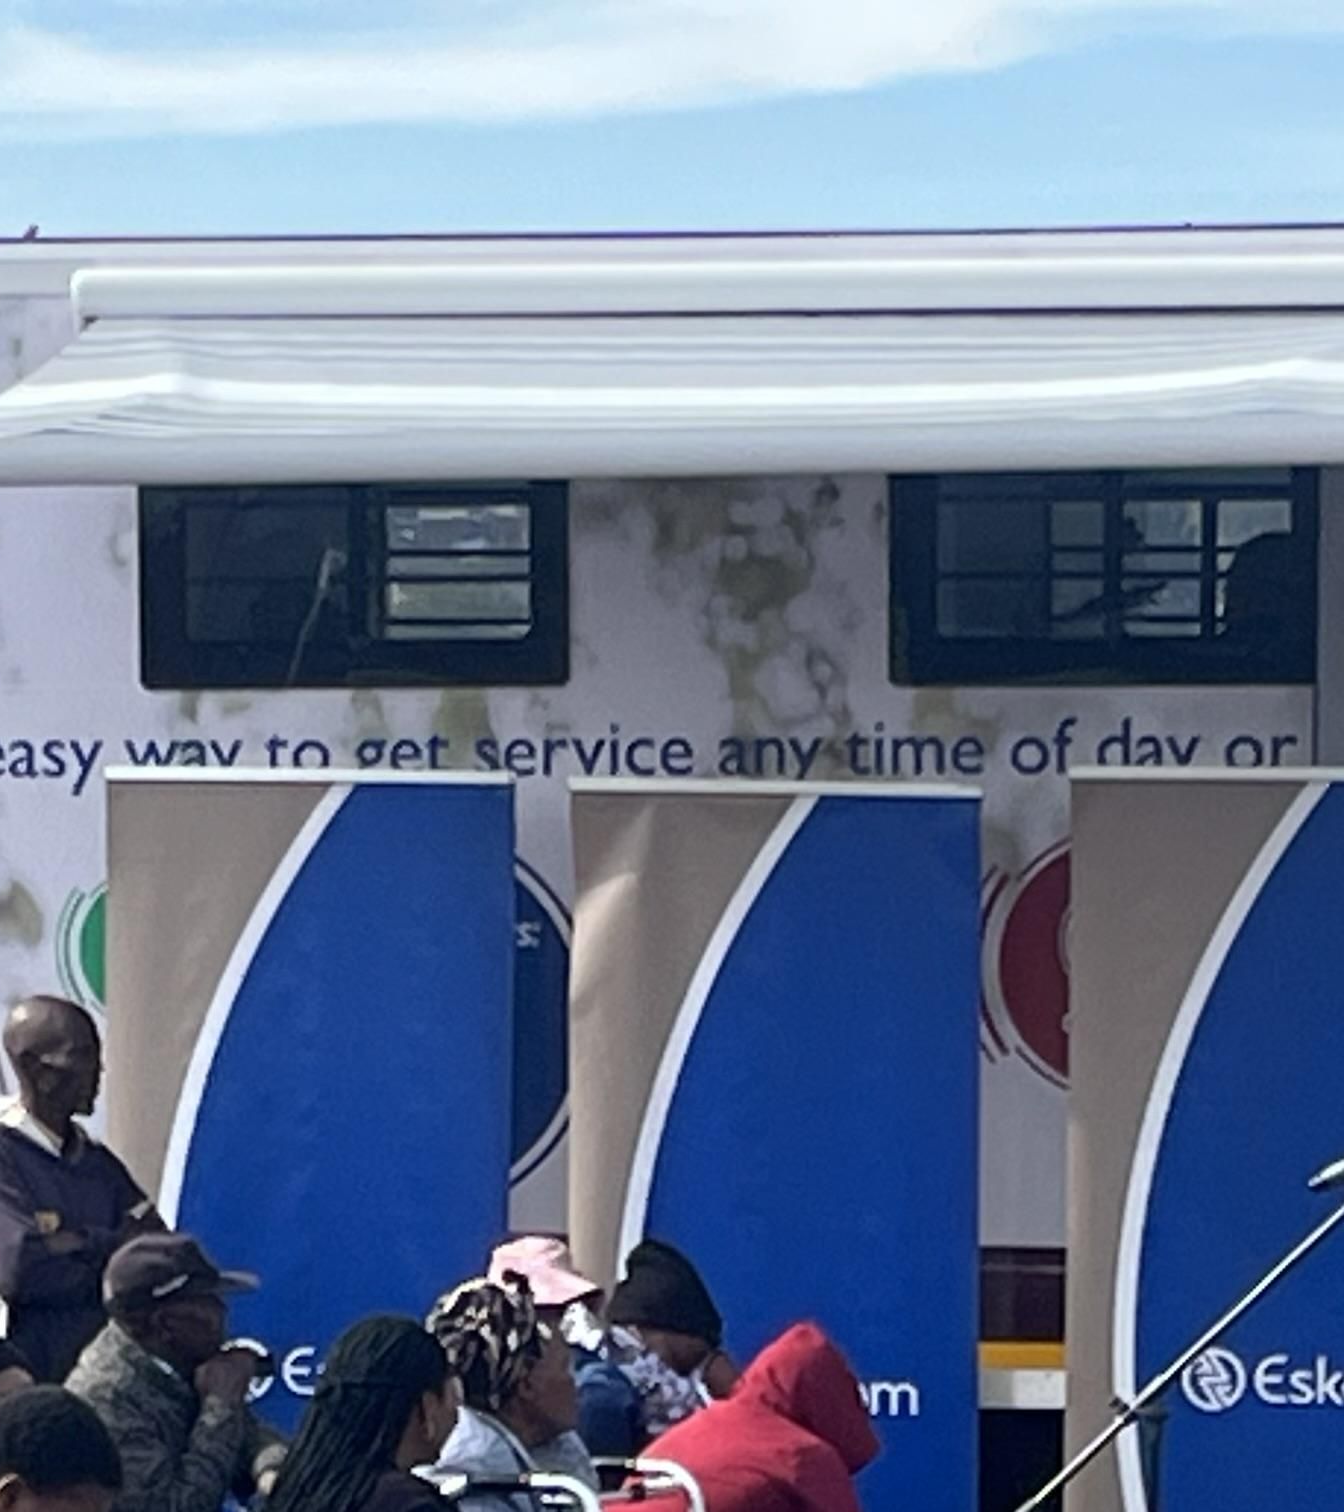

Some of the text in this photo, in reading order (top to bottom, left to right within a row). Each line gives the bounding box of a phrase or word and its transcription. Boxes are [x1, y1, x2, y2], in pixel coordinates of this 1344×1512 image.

[122, 737, 244, 767] way
[264, 732, 331, 768] to
[474, 722, 695, 777] service
[717, 735, 823, 779] any
[844, 721, 985, 776] time
[1010, 716, 1078, 775] of
[1096, 715, 1201, 767] day
[1223, 733, 1299, 767] or
